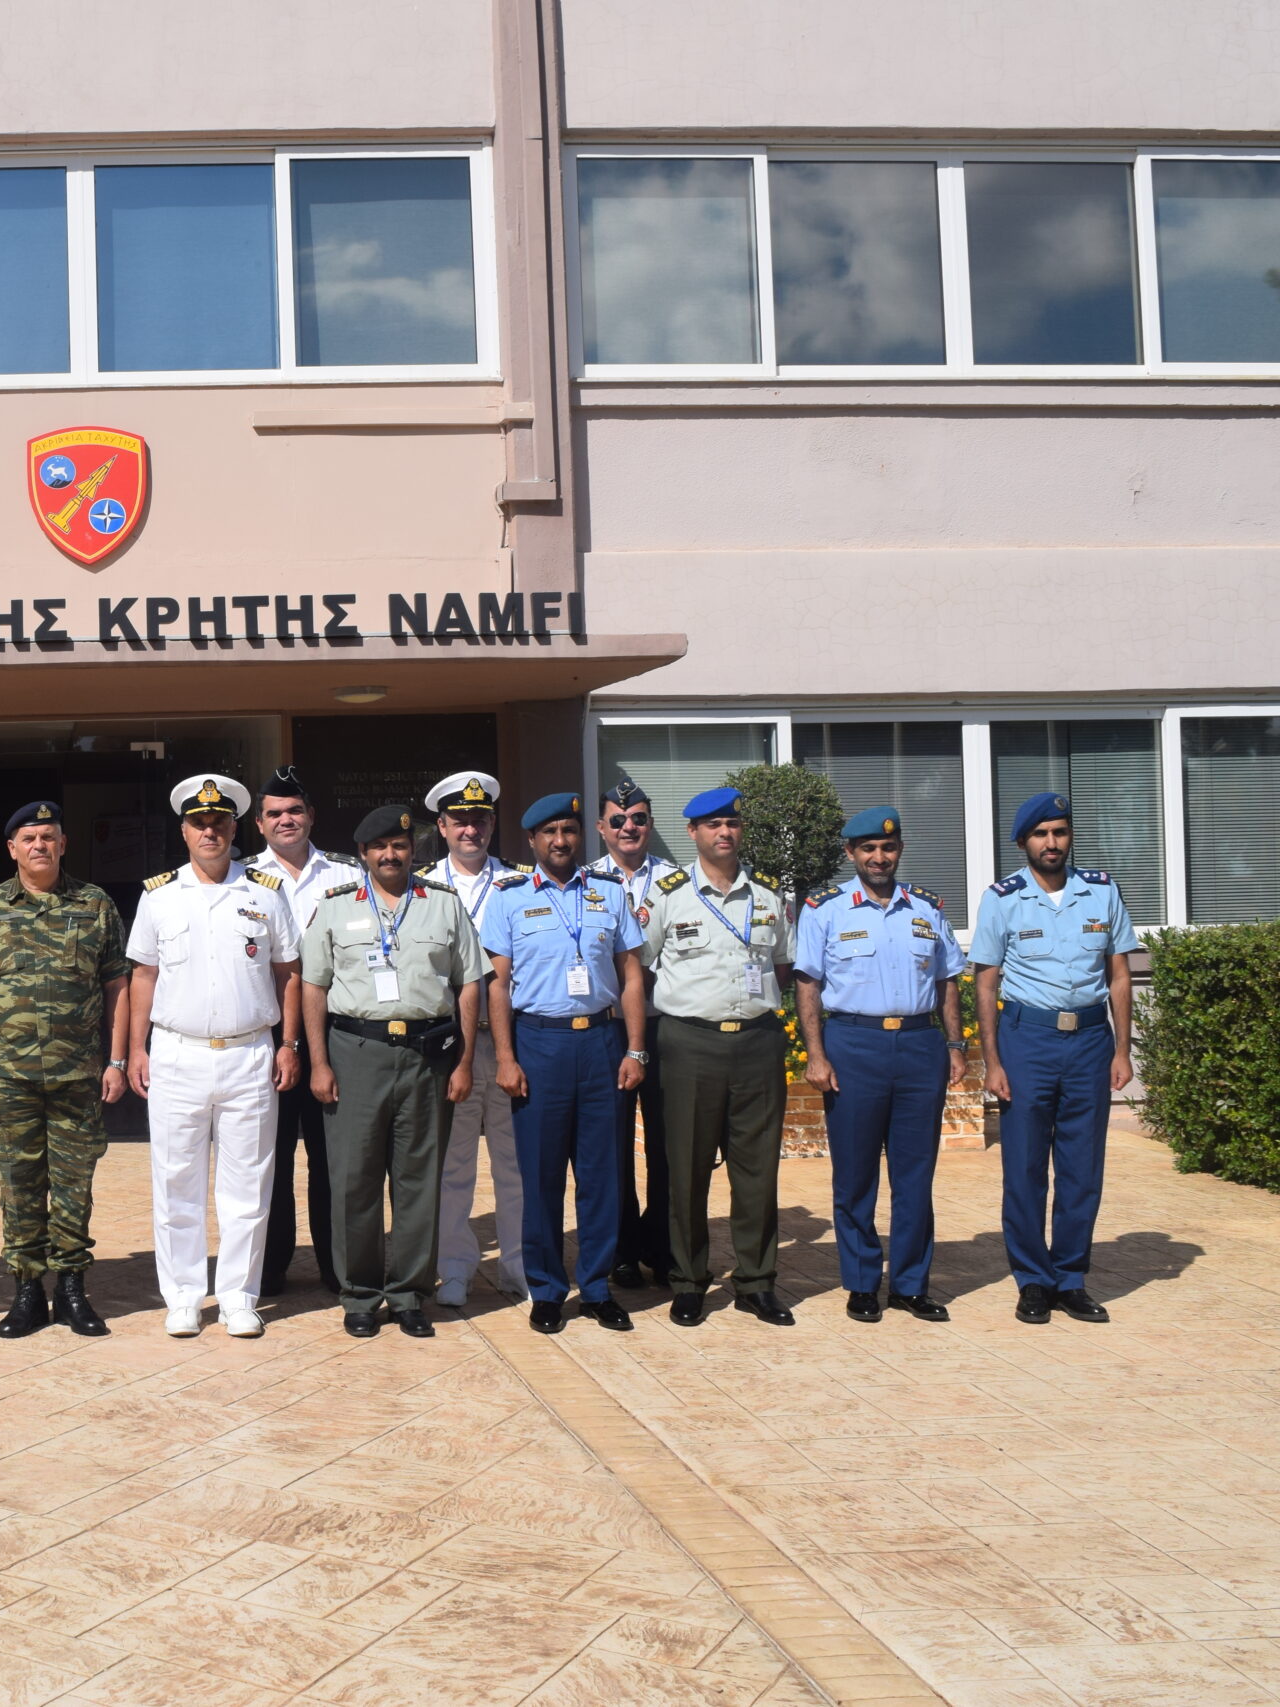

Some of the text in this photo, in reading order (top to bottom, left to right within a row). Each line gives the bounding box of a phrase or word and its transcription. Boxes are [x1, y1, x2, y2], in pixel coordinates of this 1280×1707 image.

[87, 432, 137, 449] ΤΑΧΥΤΗΣ
[98, 594, 359, 643] ΚΡΗΤΗΣ
[388, 592, 583, 638] NAMFI
